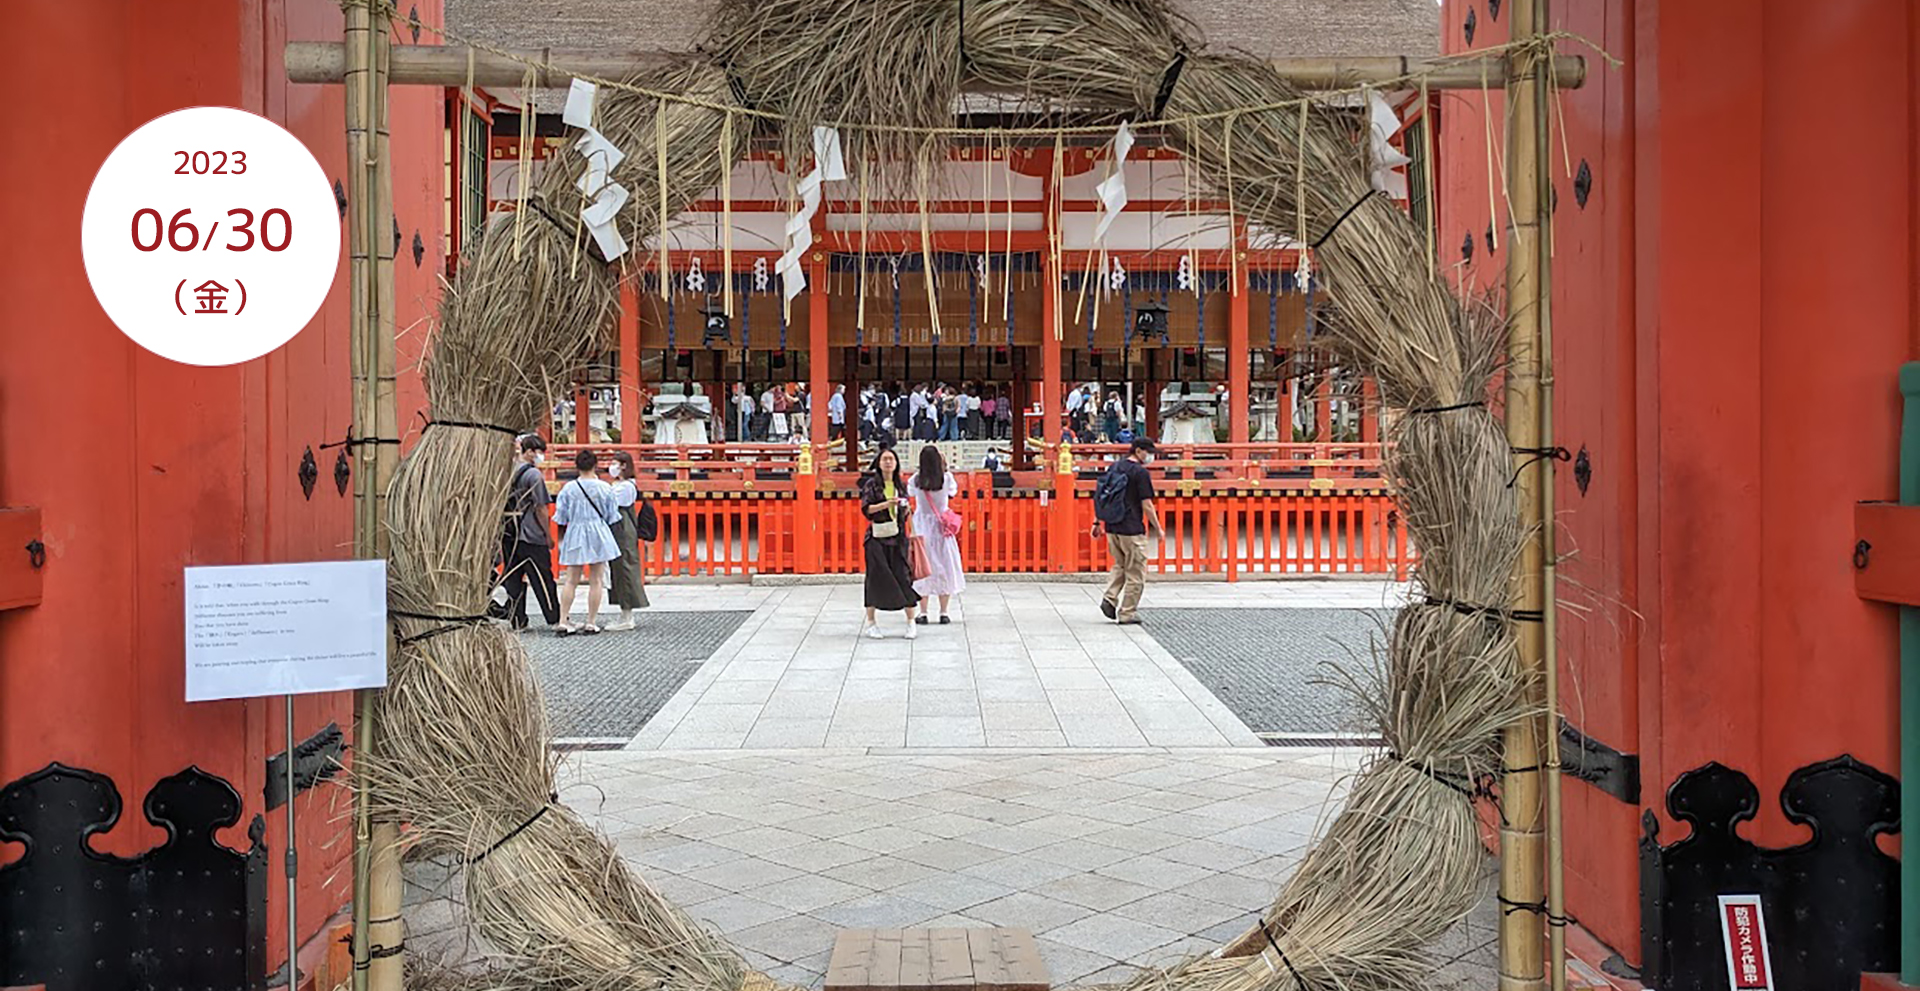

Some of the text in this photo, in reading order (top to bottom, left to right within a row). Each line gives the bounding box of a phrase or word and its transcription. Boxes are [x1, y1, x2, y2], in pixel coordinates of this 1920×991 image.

[1734, 907, 1758, 984] 防犯カメラ作動中
